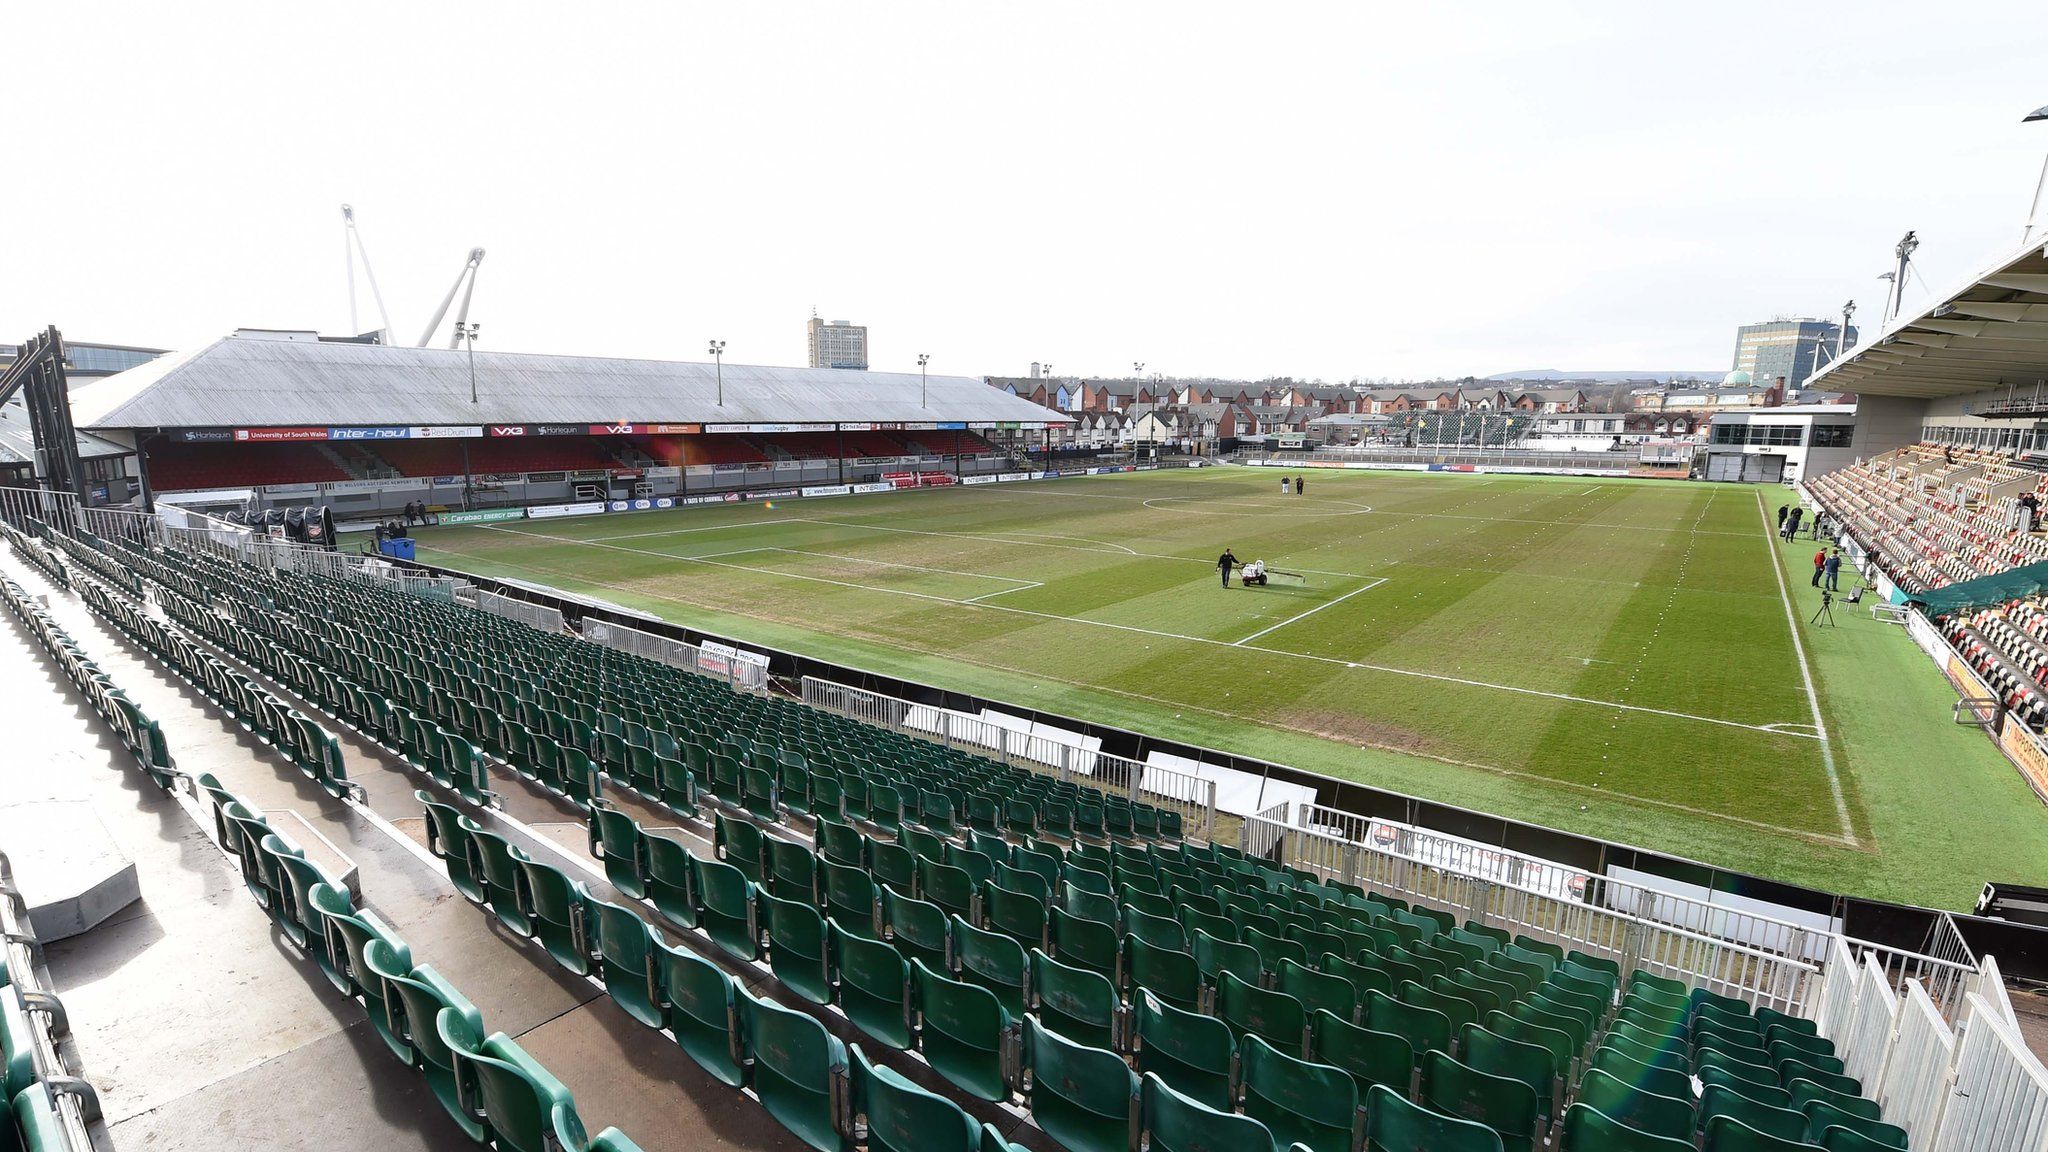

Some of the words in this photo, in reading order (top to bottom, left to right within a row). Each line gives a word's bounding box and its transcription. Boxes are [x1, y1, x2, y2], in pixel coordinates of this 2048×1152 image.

[333, 428, 406, 438] Inter-haul
[494, 427, 523, 435] VX3
[546, 426, 578, 435] Harlequin
[606, 425, 633, 434] VX3
[195, 431, 231, 440] Harlequin
[250, 432, 283, 440] University
[451, 514, 482, 522] Carabao
[483, 512, 506, 520] ENERGY
